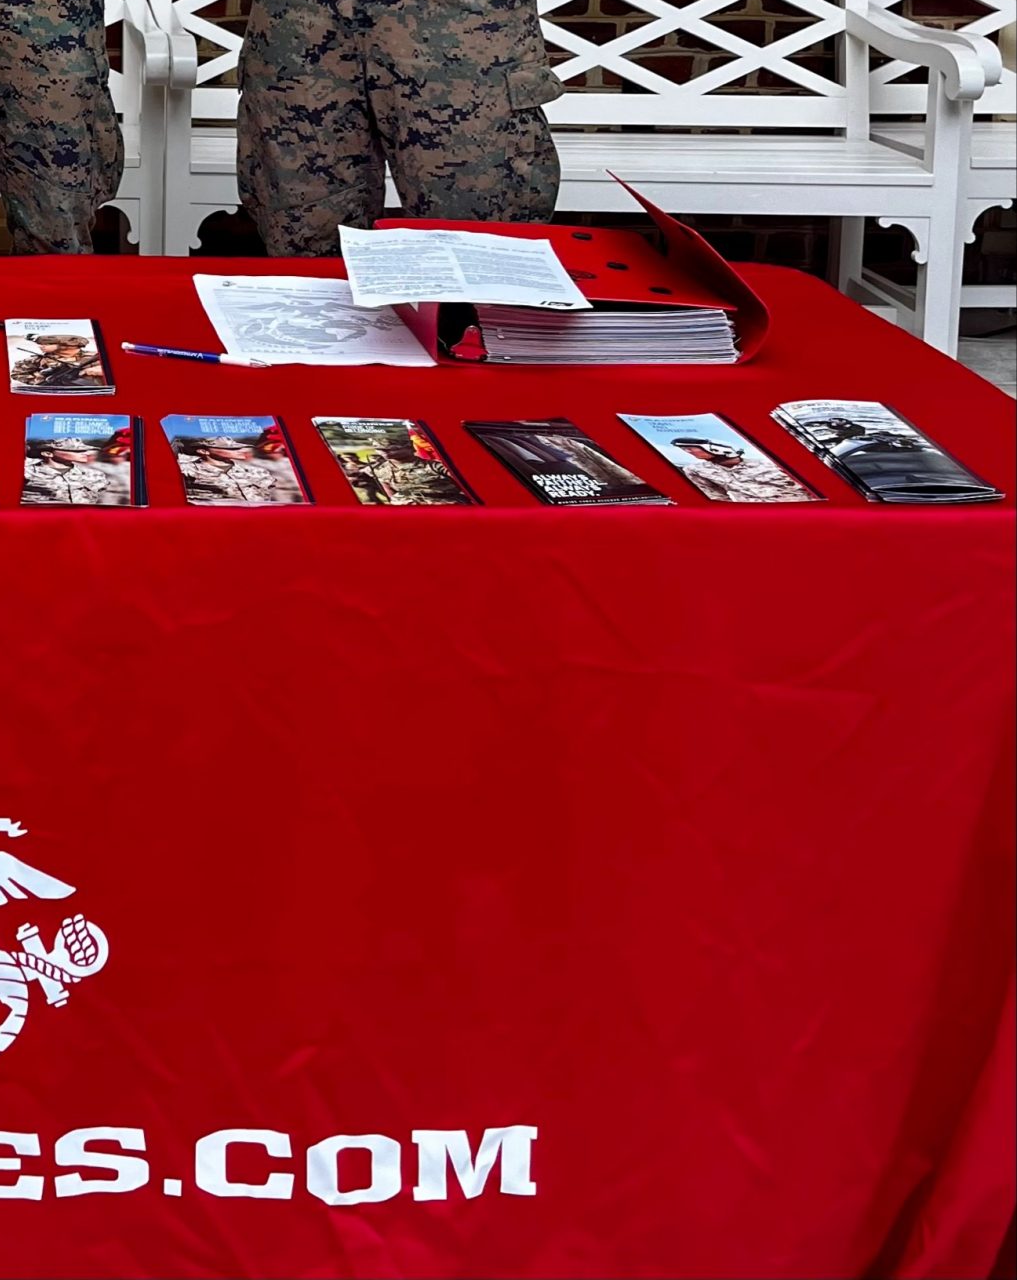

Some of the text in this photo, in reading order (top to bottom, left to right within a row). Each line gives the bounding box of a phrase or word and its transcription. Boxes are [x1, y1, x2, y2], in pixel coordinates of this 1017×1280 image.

[532, 474, 589, 482] ALWAYS
[544, 484, 602, 492] ALWAYS
[548, 490, 601, 498] READY.
